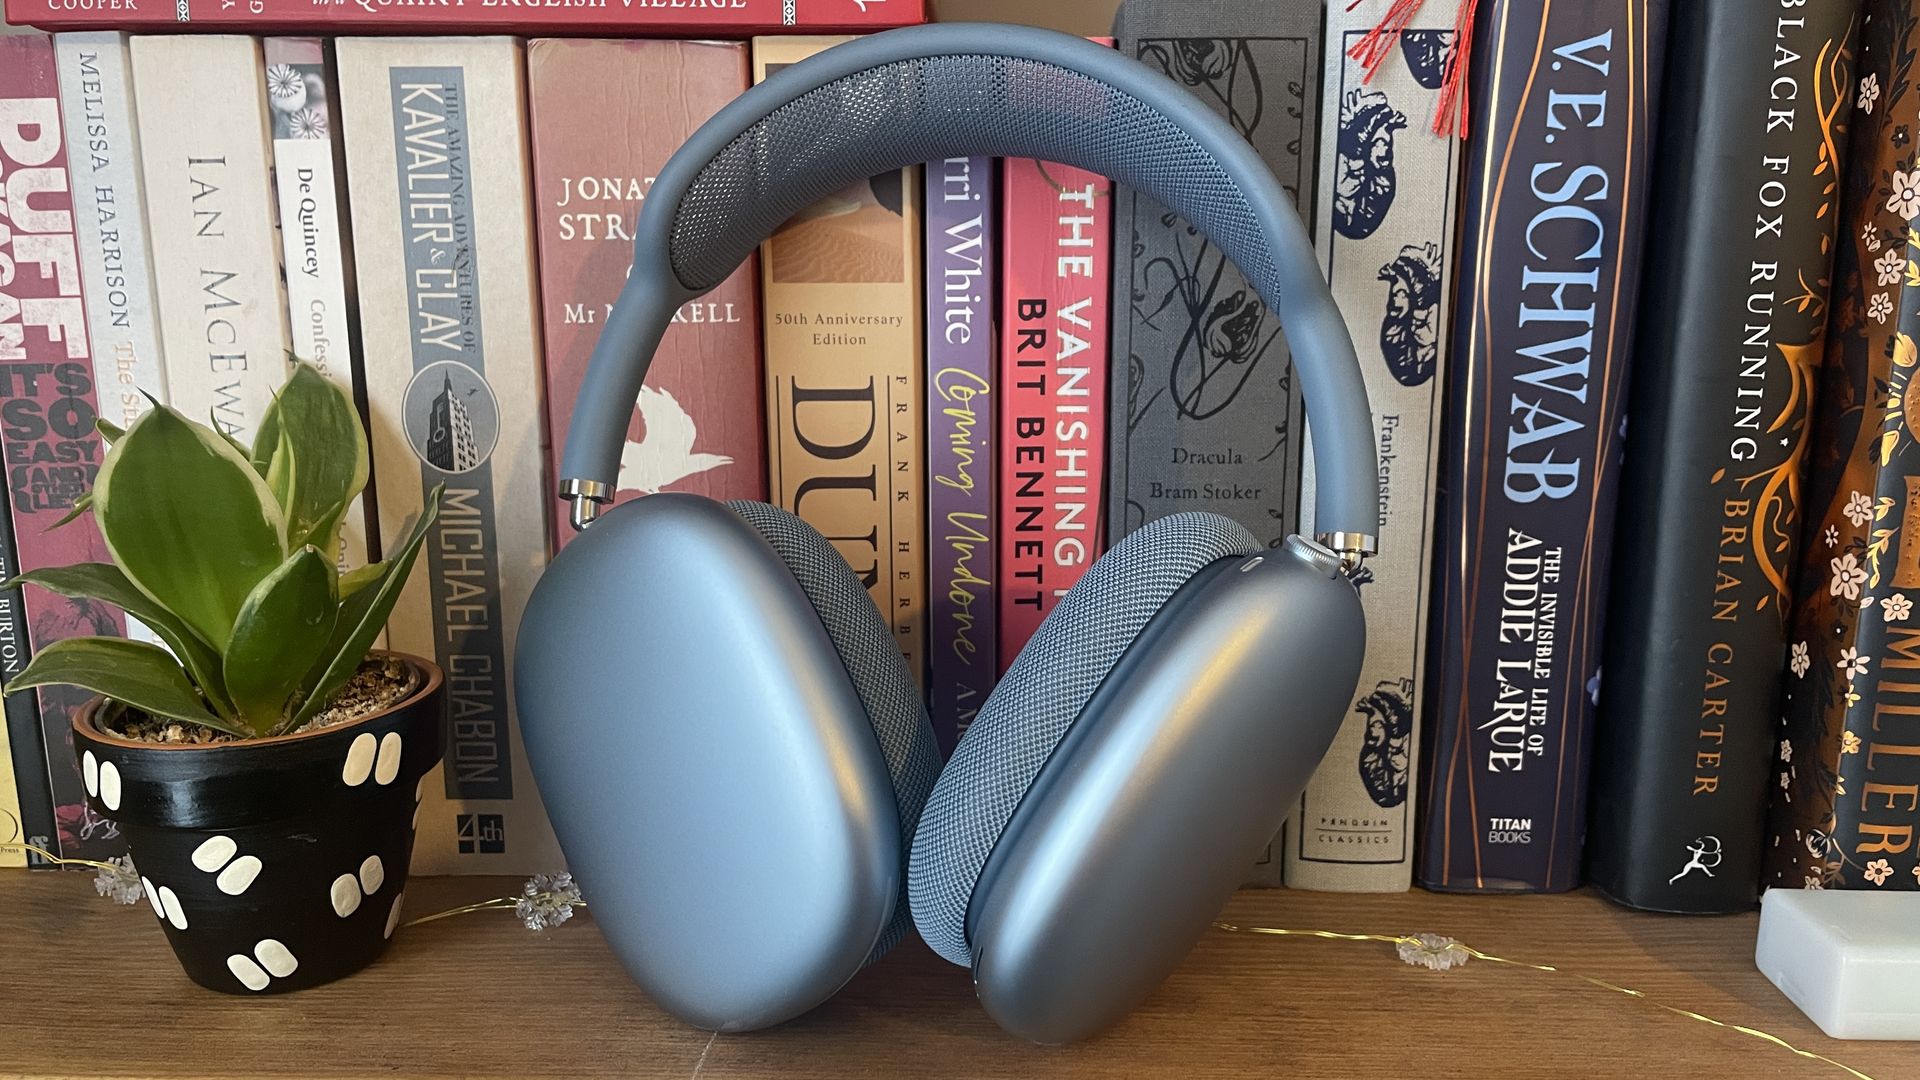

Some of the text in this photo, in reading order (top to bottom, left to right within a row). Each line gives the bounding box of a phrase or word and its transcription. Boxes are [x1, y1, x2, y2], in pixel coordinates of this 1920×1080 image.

[79, 52, 130, 328] MELISSA HARRISON
[401, 84, 453, 243] KAVALIER
[448, 125, 465, 206] AMAZING
[557, 177, 656, 206] JONA
[1755, 155, 1790, 240] FOX
[0, 98, 89, 359] DUFF
[298, 168, 319, 278] De Quincey
[944, 157, 983, 345] rri White
[1058, 184, 1095, 278] THE
[187, 155, 248, 436] IAN MCEWA
[416, 269, 462, 351] CLAY
[565, 303, 595, 323] Mr
[775, 312, 904, 327] 50th Anniversary
[813, 333, 867, 345] Edition
[1503, 161, 1609, 503] SCHWAB
[117, 341, 136, 385] The
[1730, 261, 1778, 462] RUNNING
[2, 398, 97, 441] SO
[7, 441, 98, 464] EASY
[896, 376, 909, 501] FRANK
[935, 368, 990, 497] Coming
[1014, 299, 1047, 611] BRIT BENNETT
[1052, 297, 1092, 567] VANISHING
[1171, 448, 1242, 465] Dracula
[1379, 414, 1400, 526] Frankenstein
[1150, 483, 1262, 500] Bram Stoker
[0, 599, 19, 673] BURTON
[439, 489, 498, 782] MICHAEL CHABON
[945, 513, 991, 665] Undone
[1499, 528, 1543, 643] ADDIE
[1527, 547, 1562, 757] THE INVISIBLE LIFE OF
[1692, 498, 1750, 796] BRIAN CARTER
[1318, 835, 1390, 844] CLASSICS
[1321, 817, 1389, 827] PENGUIN
[1488, 831, 1531, 844] BOOKS
[1490, 818, 1531, 830] TITAN
